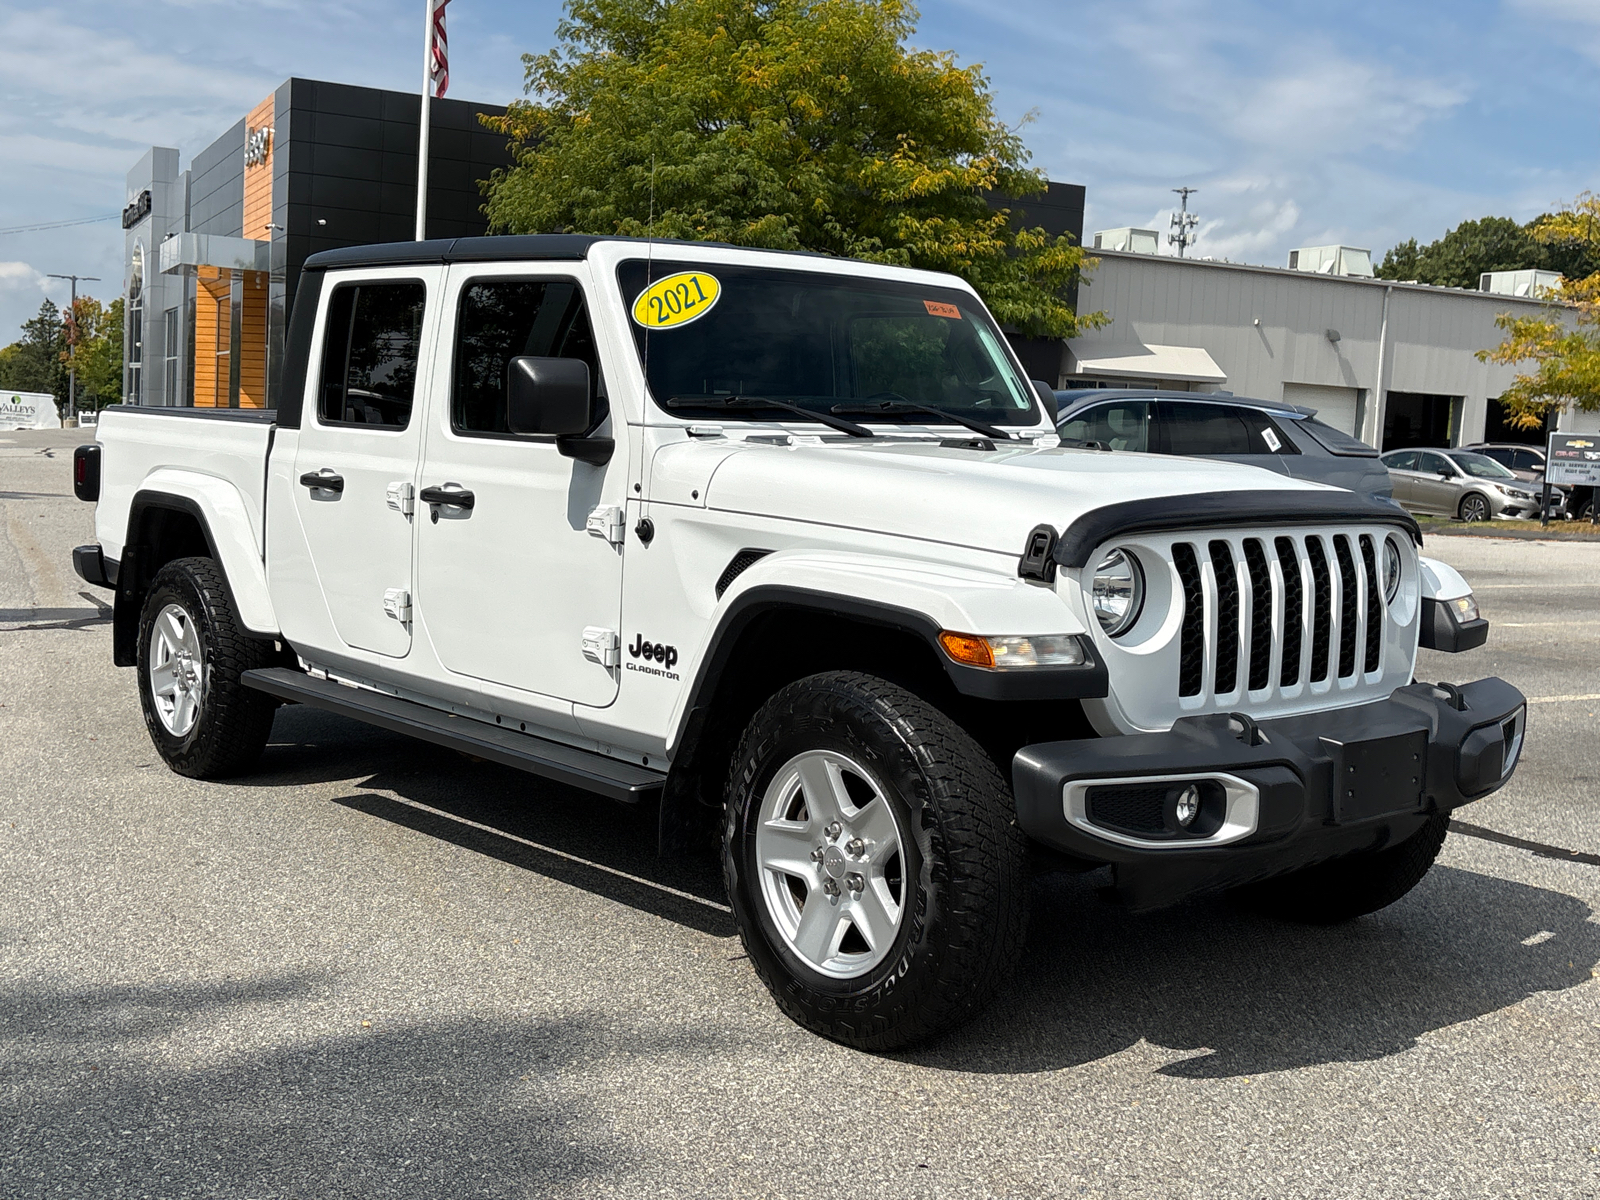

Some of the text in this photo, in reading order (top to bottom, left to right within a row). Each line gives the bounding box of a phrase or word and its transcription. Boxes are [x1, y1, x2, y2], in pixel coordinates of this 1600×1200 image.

[649, 276, 709, 324] 2021
[628, 633, 678, 670] Jeep
[626, 662, 680, 682] GLADIATOR
